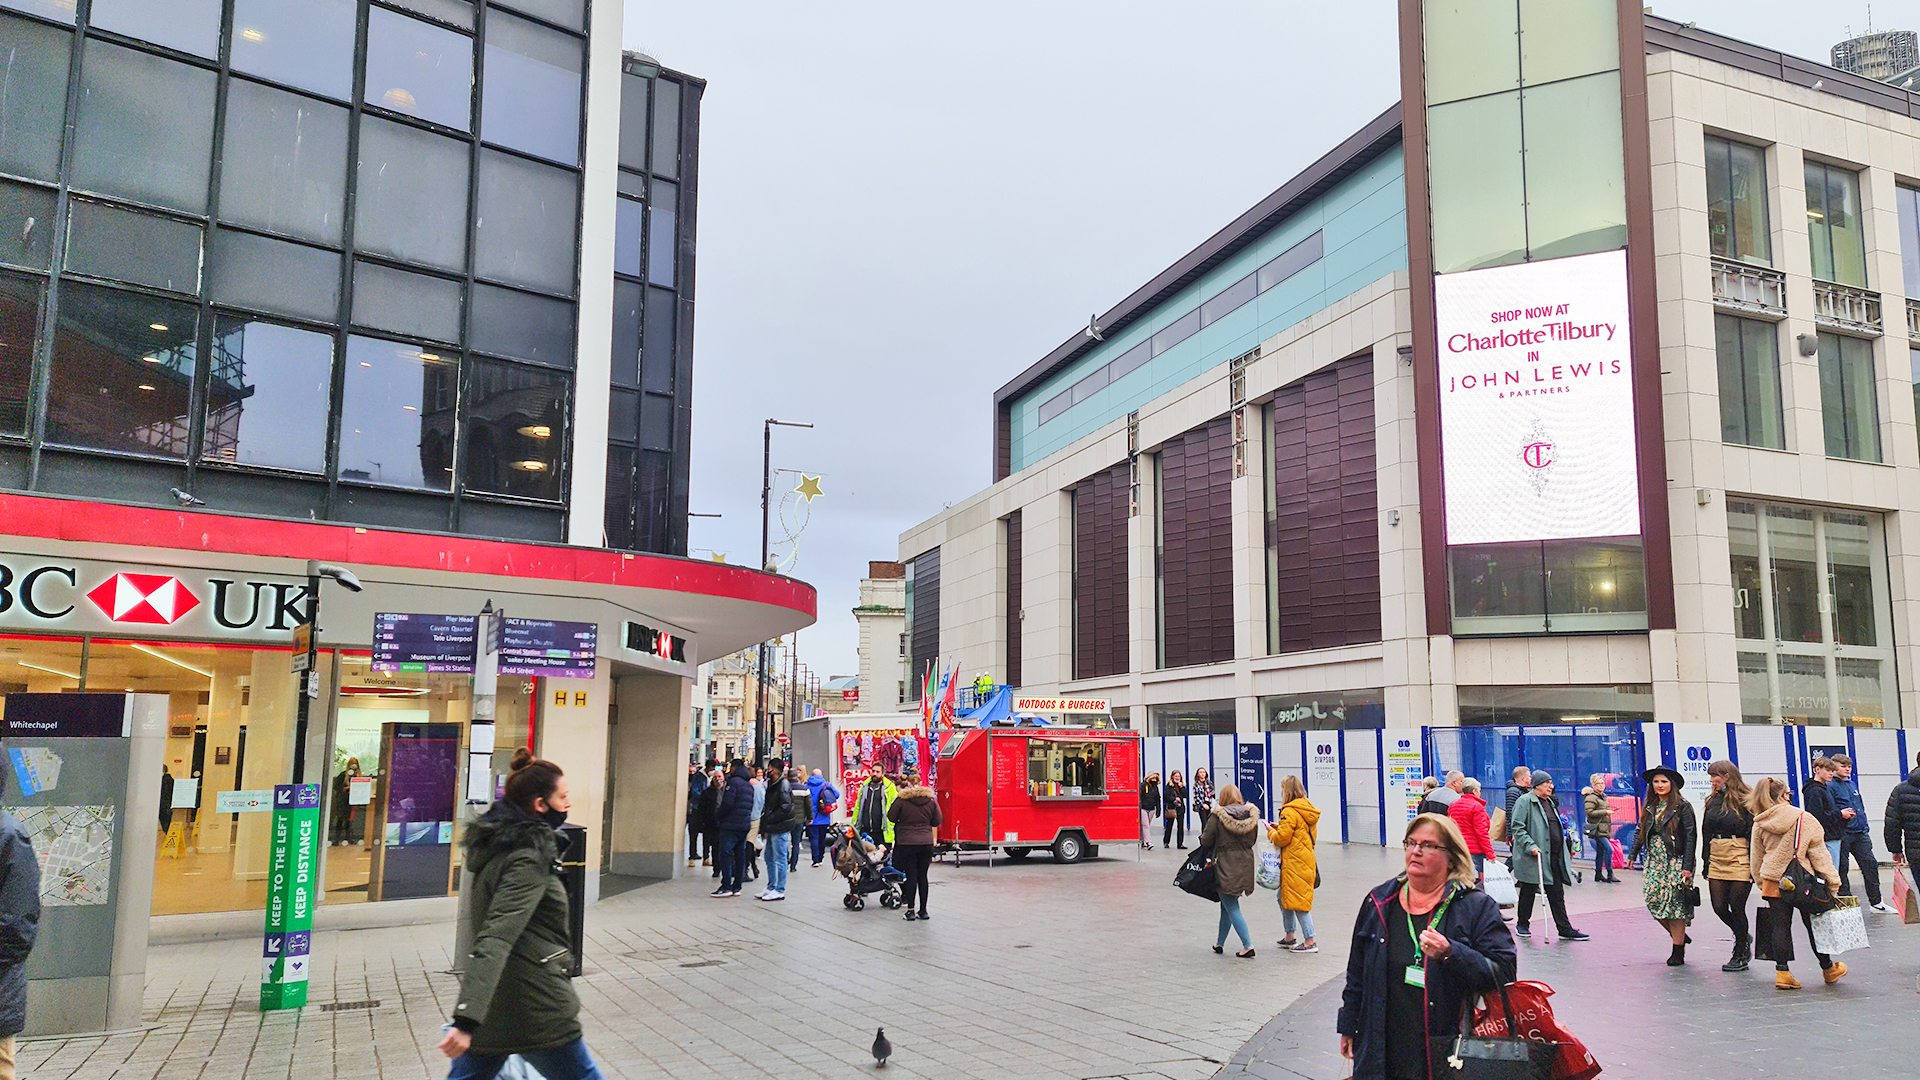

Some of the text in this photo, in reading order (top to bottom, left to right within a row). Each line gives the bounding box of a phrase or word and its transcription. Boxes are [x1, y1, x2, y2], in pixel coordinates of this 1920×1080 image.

[1491, 303, 1570, 323] SHOP NOW AT
[1527, 351, 1540, 362] IN
[1450, 359, 1621, 392] JOHN LEWIS
[1510, 386, 1571, 398] PARTNERS
[208, 578, 322, 631] UK
[445, 615, 458, 623] Pier
[429, 624, 474, 633] Cavern Quarter
[410, 653, 437, 661] Museum
[445, 654, 471, 662] Liverpool
[517, 667, 535, 675] Street
[363, 678, 396, 686] Welcome
[1018, 698, 1106, 710] HOTDOGS & BURGERS
[9, 720, 58, 731] Whitechapel
[843, 769, 873, 779] CHA
[1315, 771, 1335, 780] next
[271, 814, 288, 927] KEEP TO THE LEFT
[294, 819, 312, 919] KEEP DISTANCE
[1474, 1008, 1537, 1036] HRISTAS
